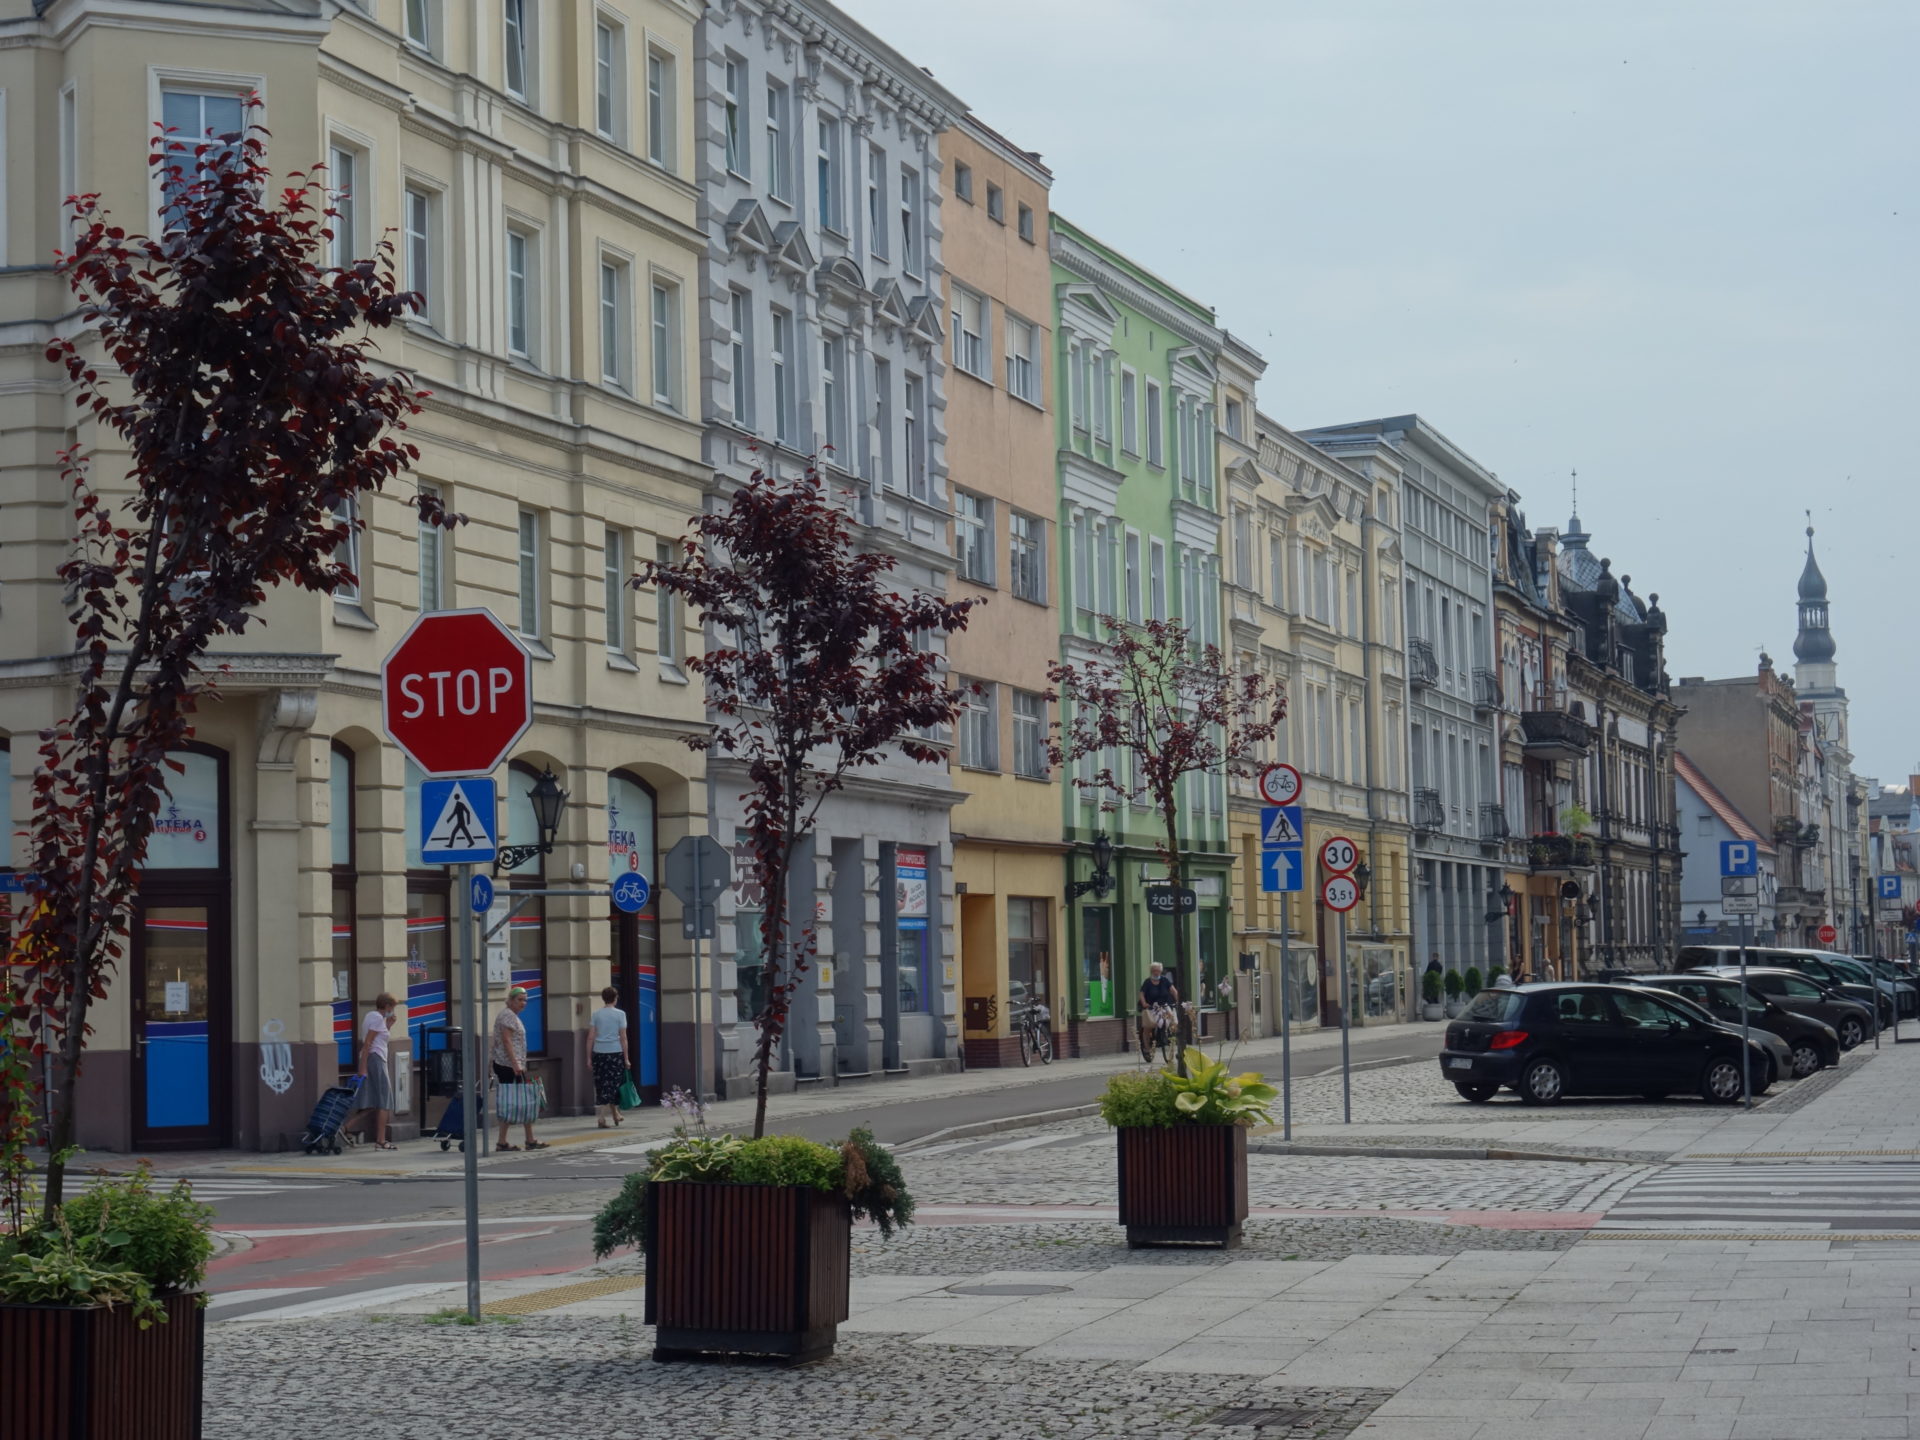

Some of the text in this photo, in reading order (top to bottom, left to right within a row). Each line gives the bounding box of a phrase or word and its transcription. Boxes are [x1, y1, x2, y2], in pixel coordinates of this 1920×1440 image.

[400, 667, 513, 719] STOP
[155, 819, 203, 829] PTEKA
[608, 829, 636, 847] TEKA
[1327, 846, 1353, 864] 30
[1728, 844, 1749, 872] P
[1883, 877, 1897, 895] P
[1329, 888, 1353, 903] 3,5 t
